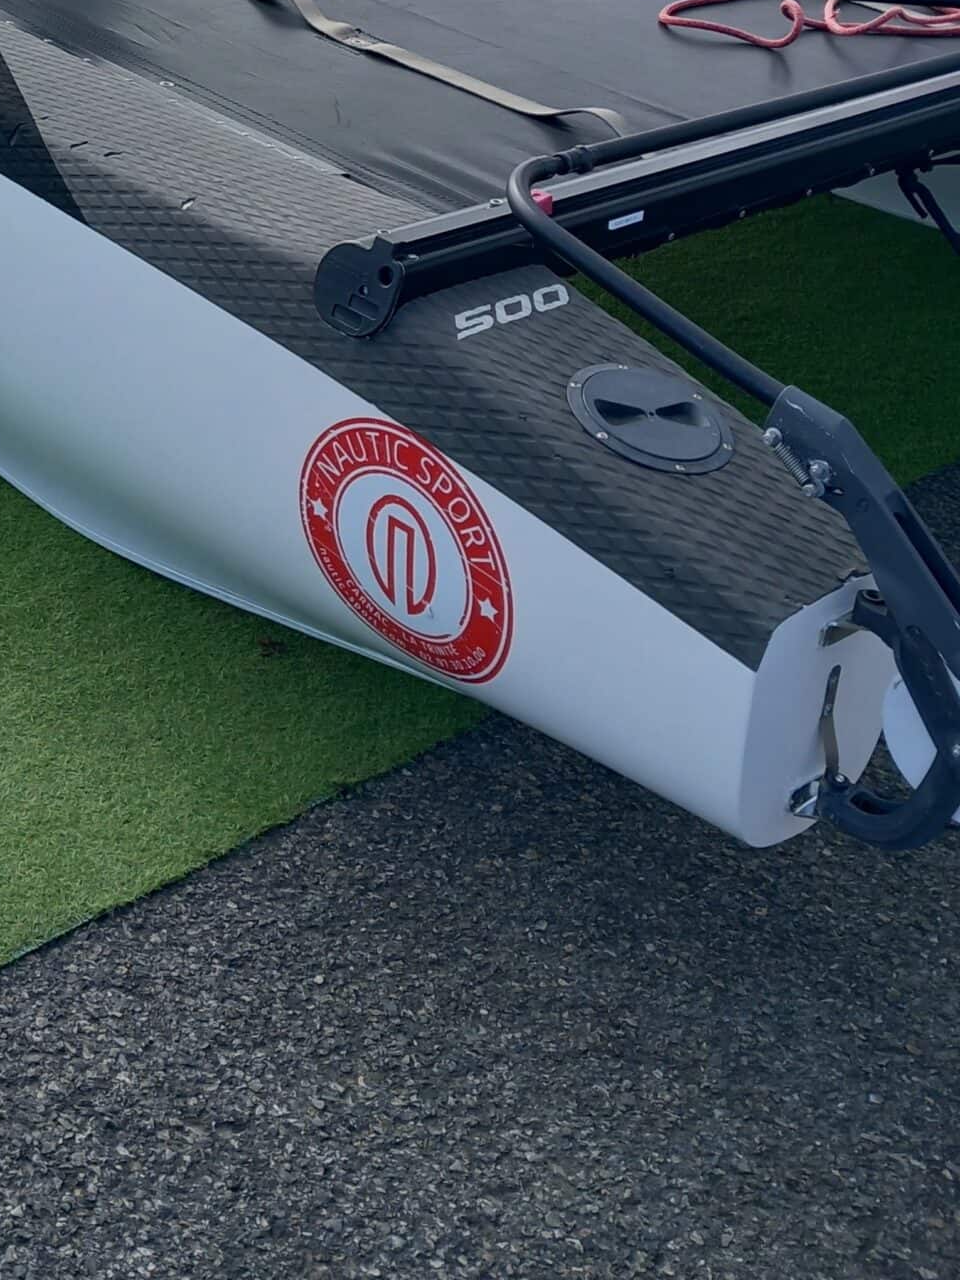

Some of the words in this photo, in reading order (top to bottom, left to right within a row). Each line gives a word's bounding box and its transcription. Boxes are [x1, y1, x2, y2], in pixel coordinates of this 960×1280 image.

[454, 284, 570, 341] 500
[316, 431, 410, 485] NAUTIC
[416, 457, 495, 571] SPORT
